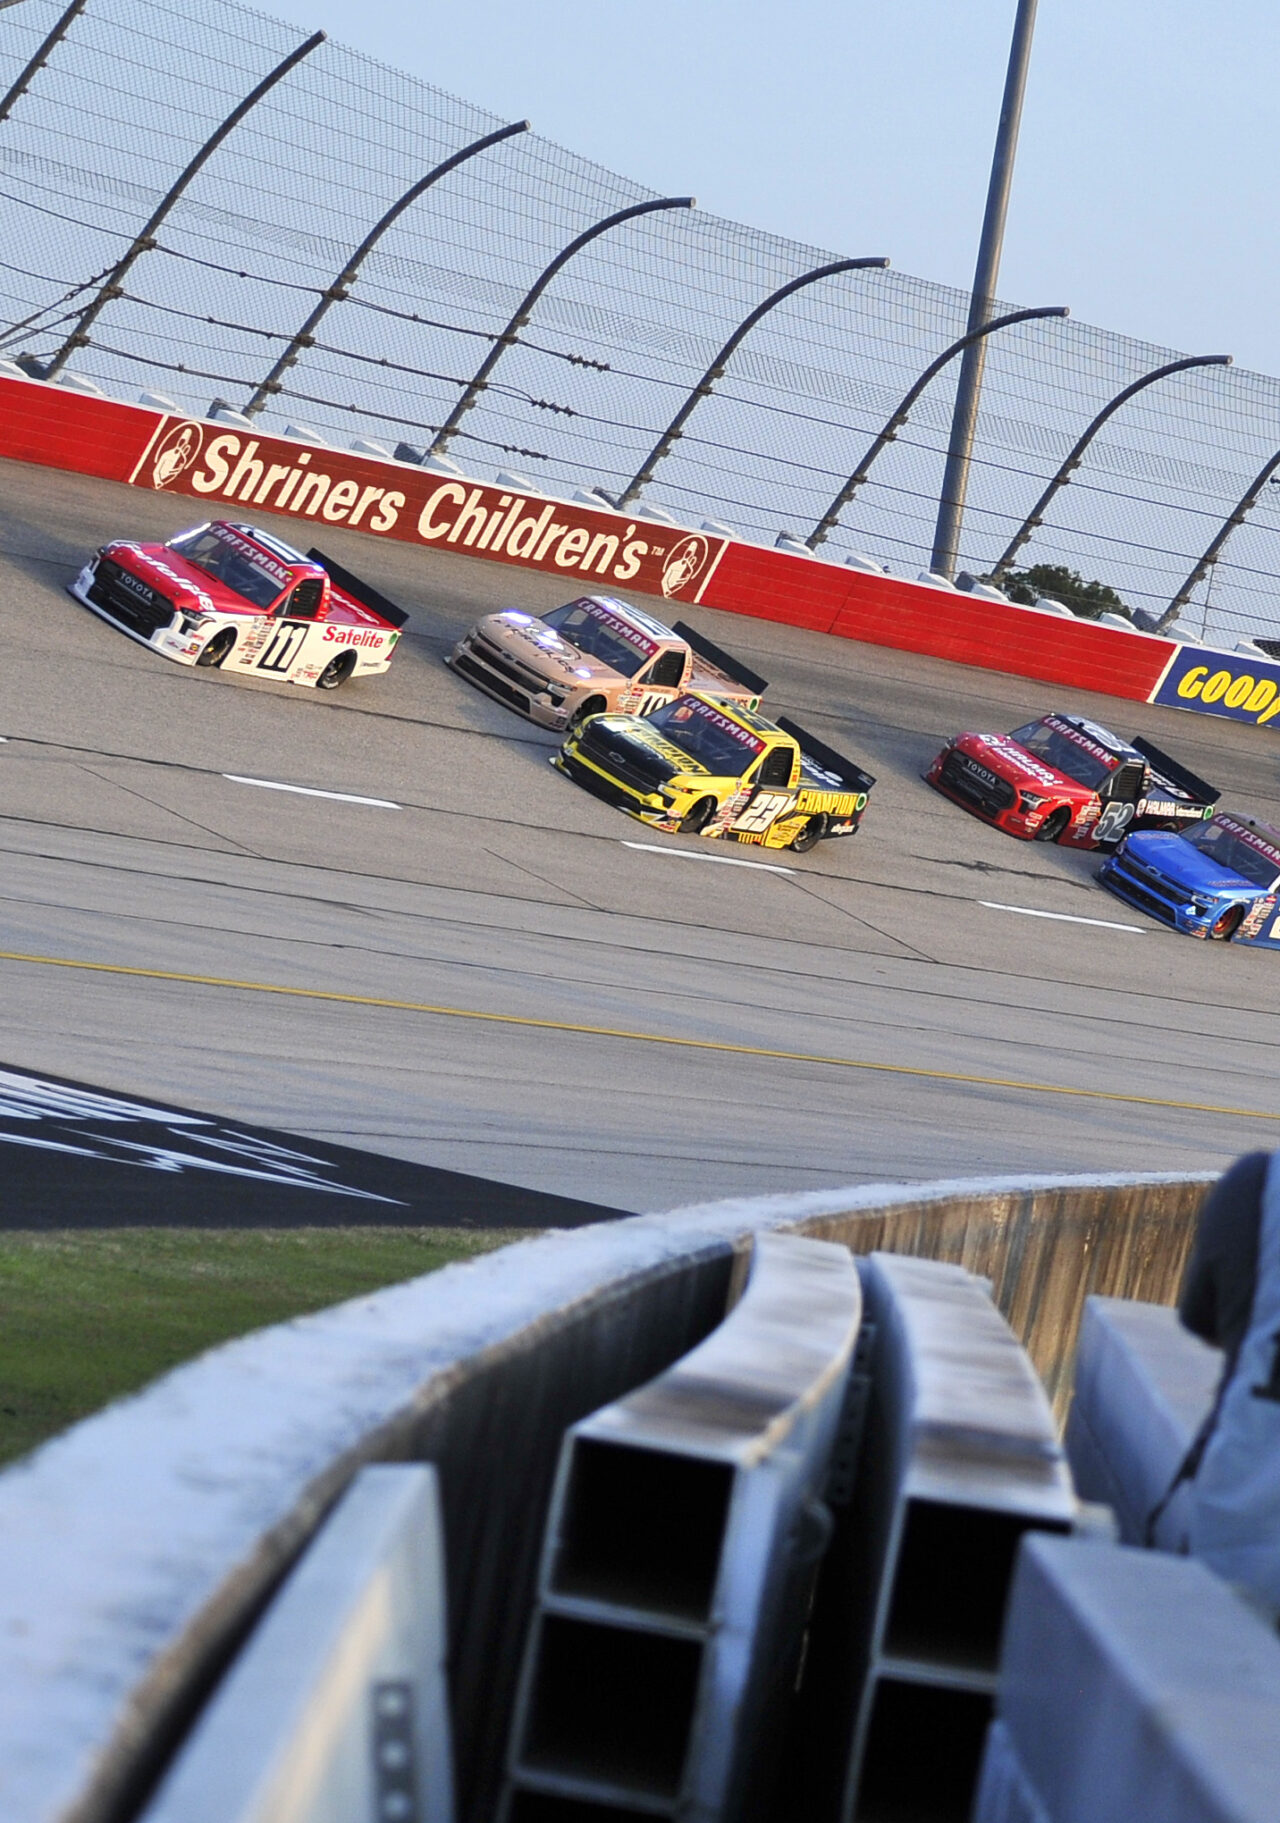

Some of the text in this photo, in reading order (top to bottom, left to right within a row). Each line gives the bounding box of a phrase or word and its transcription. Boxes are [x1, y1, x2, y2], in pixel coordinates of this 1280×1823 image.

[192, 434, 405, 532] Shriners
[417, 482, 648, 581] Children's
[208, 525, 288, 580] CRAFTSMAN
[120, 572, 155, 600] TOYOTA
[263, 624, 308, 669] 11
[322, 626, 384, 649] Safelite
[577, 600, 651, 651] CRAFTSMAN
[682, 697, 759, 748] CRAFTSMAN
[1044, 717, 1113, 763] CRAFTSMAN
[966, 760, 997, 784] TOYOTA
[731, 793, 789, 833] 23
[797, 790, 858, 817] CHAMPION
[1091, 801, 1135, 843] 52
